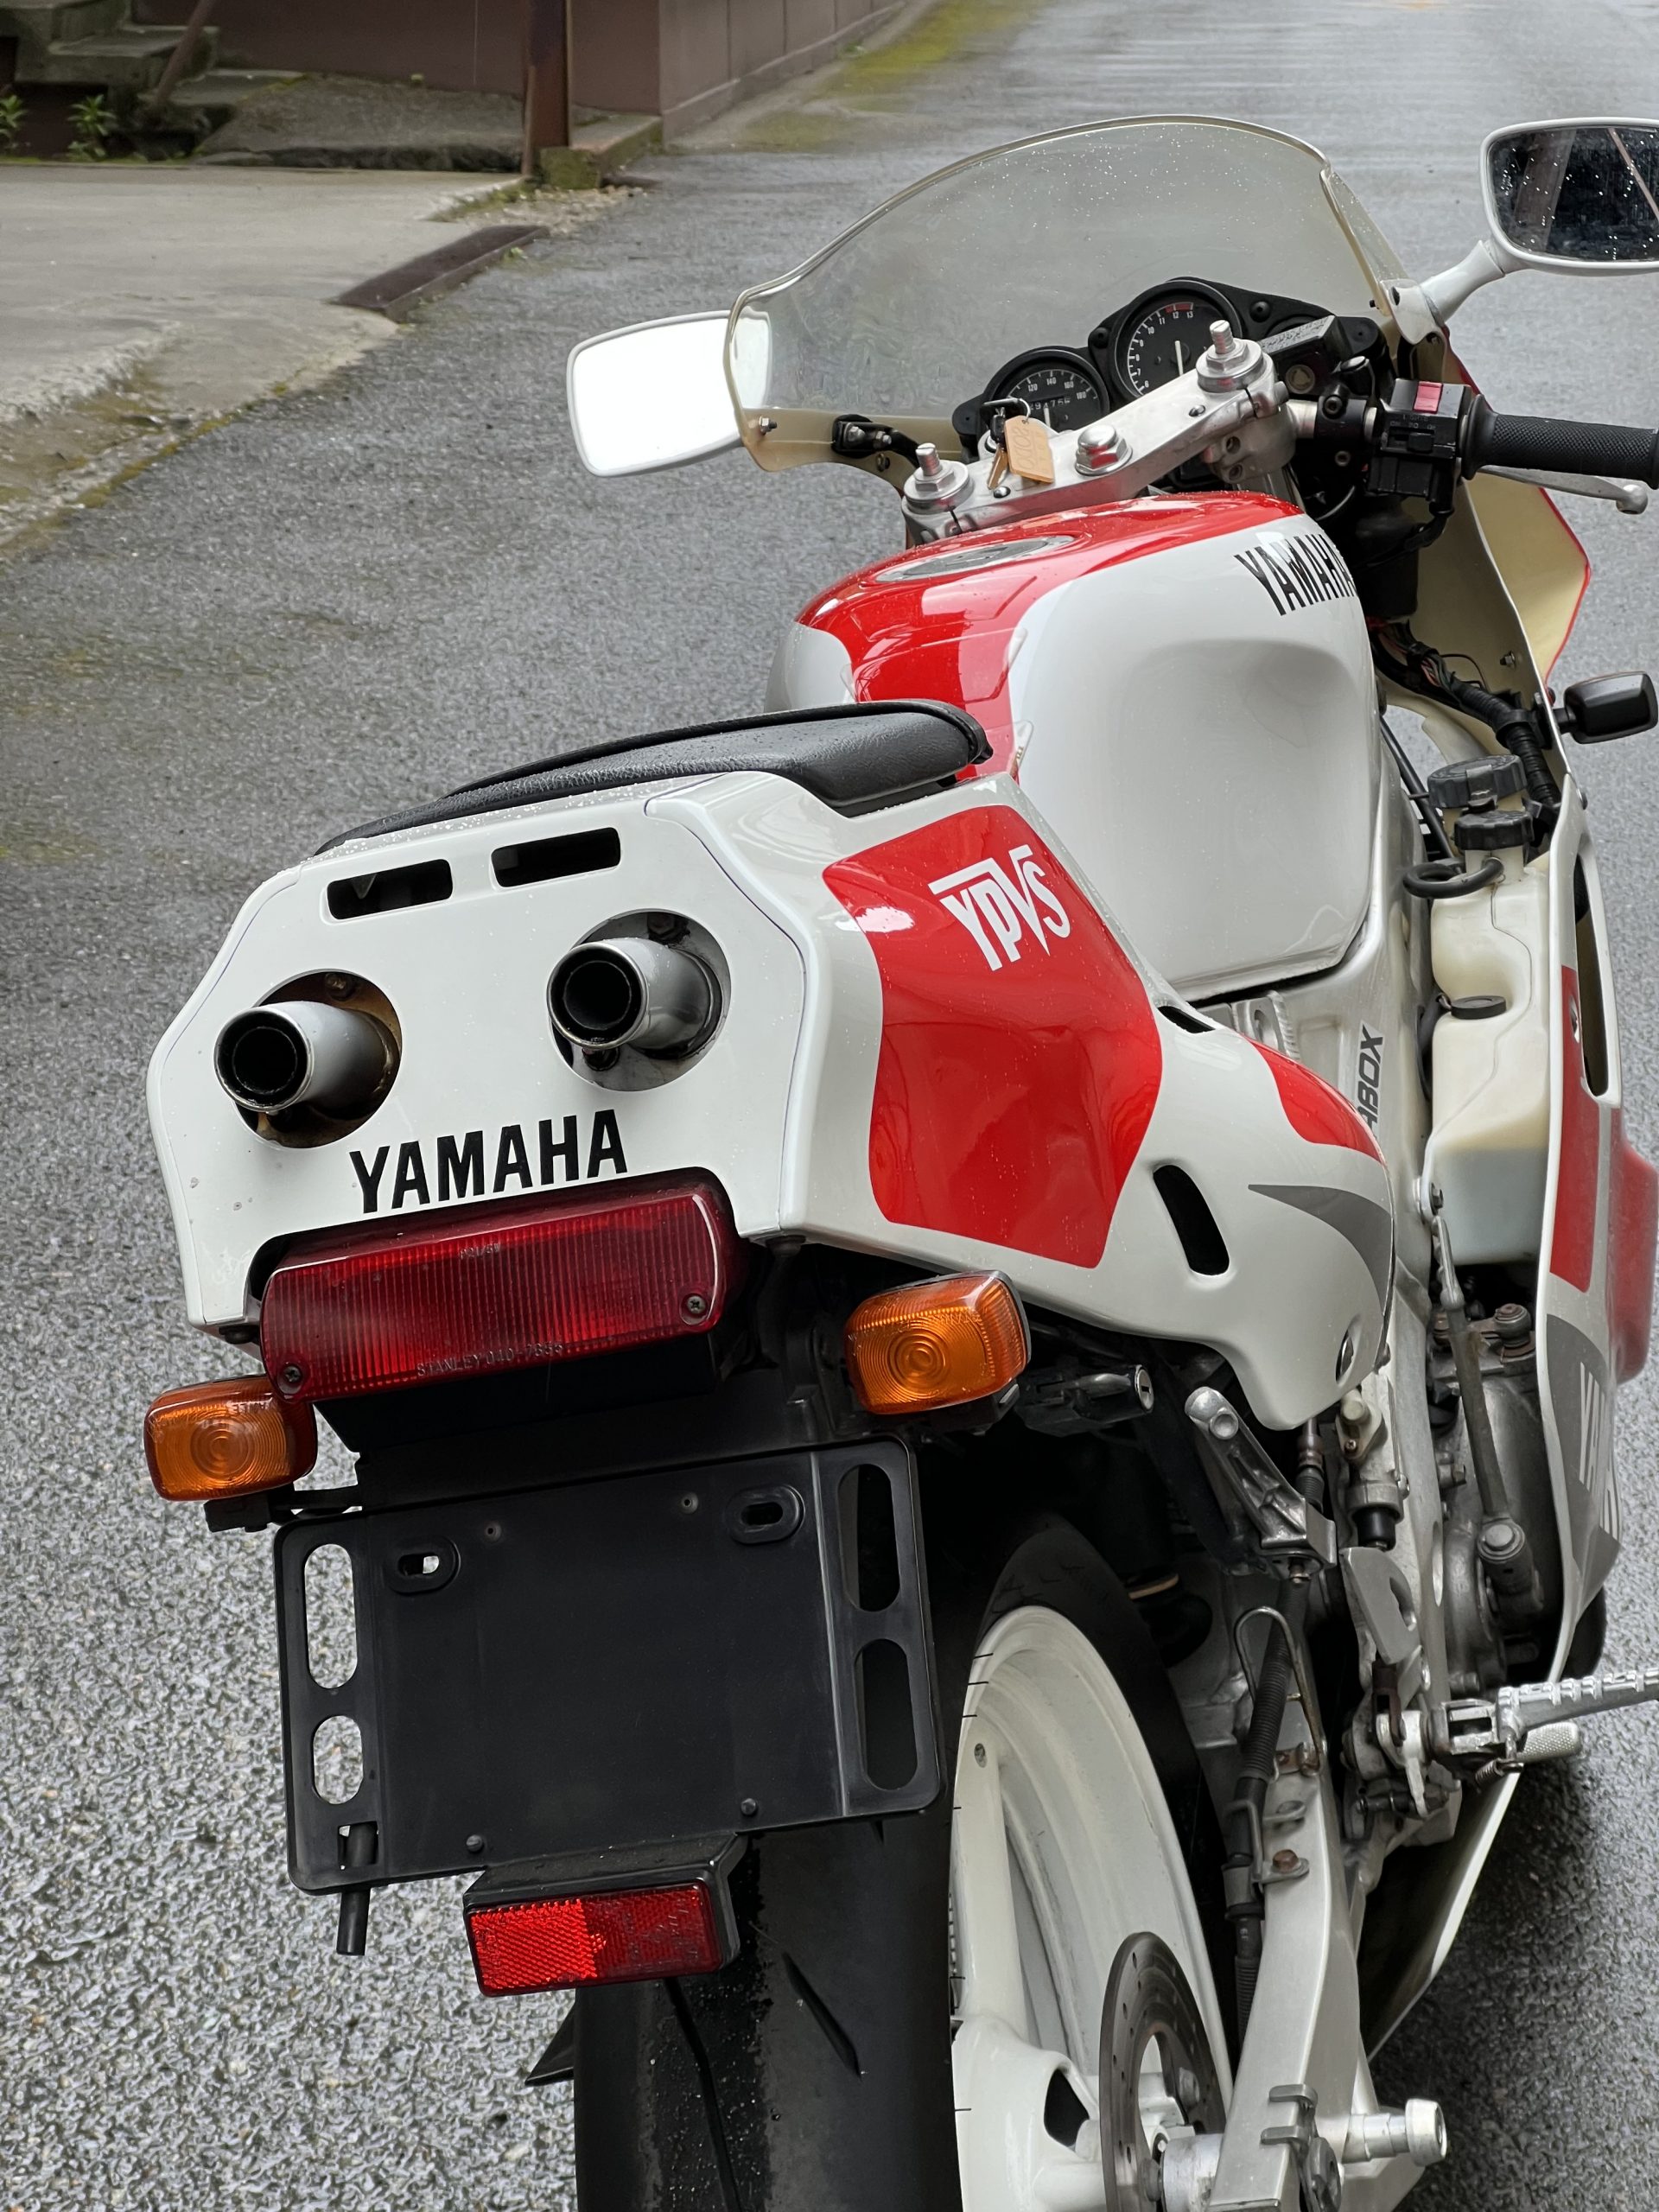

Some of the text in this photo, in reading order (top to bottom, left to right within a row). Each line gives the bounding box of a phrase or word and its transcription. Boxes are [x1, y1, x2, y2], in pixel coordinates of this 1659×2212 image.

[1172, 311, 1179, 320] 12
[1186, 311, 1194, 320] 13
[1147, 327, 1155, 335] 10
[1046, 377, 1057, 385] 140
[1064, 381, 1074, 390] 160
[1027, 383, 1038, 391] 120
[927, 844, 1071, 971] YPVS
[349, 1109, 627, 1214] YAMAHA
[416, 1353, 481, 1376] STANLEY
